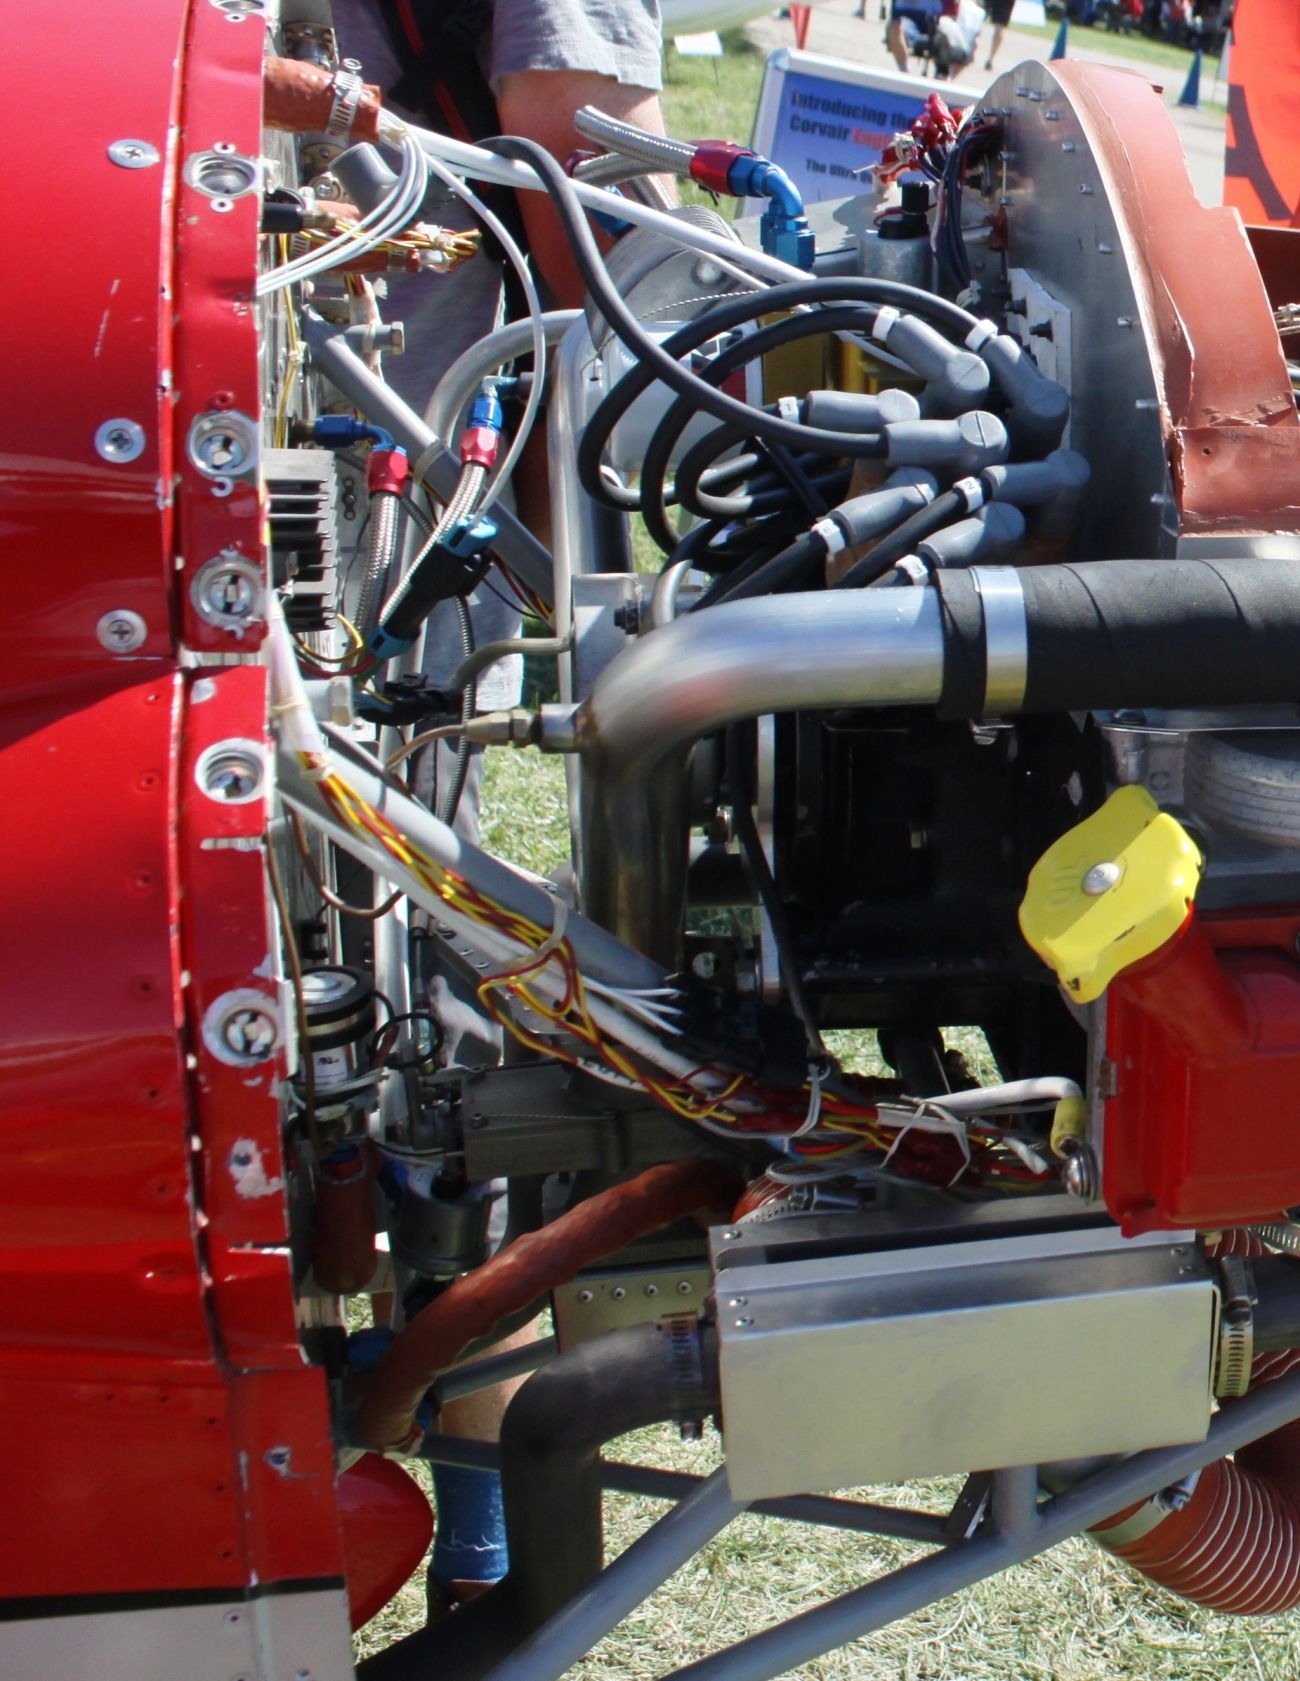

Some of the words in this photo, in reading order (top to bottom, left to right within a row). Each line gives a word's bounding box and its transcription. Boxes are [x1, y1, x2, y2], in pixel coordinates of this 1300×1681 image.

[791, 90, 888, 127] Introducing
[790, 114, 849, 142] Corvair
[806, 158, 827, 175] The
